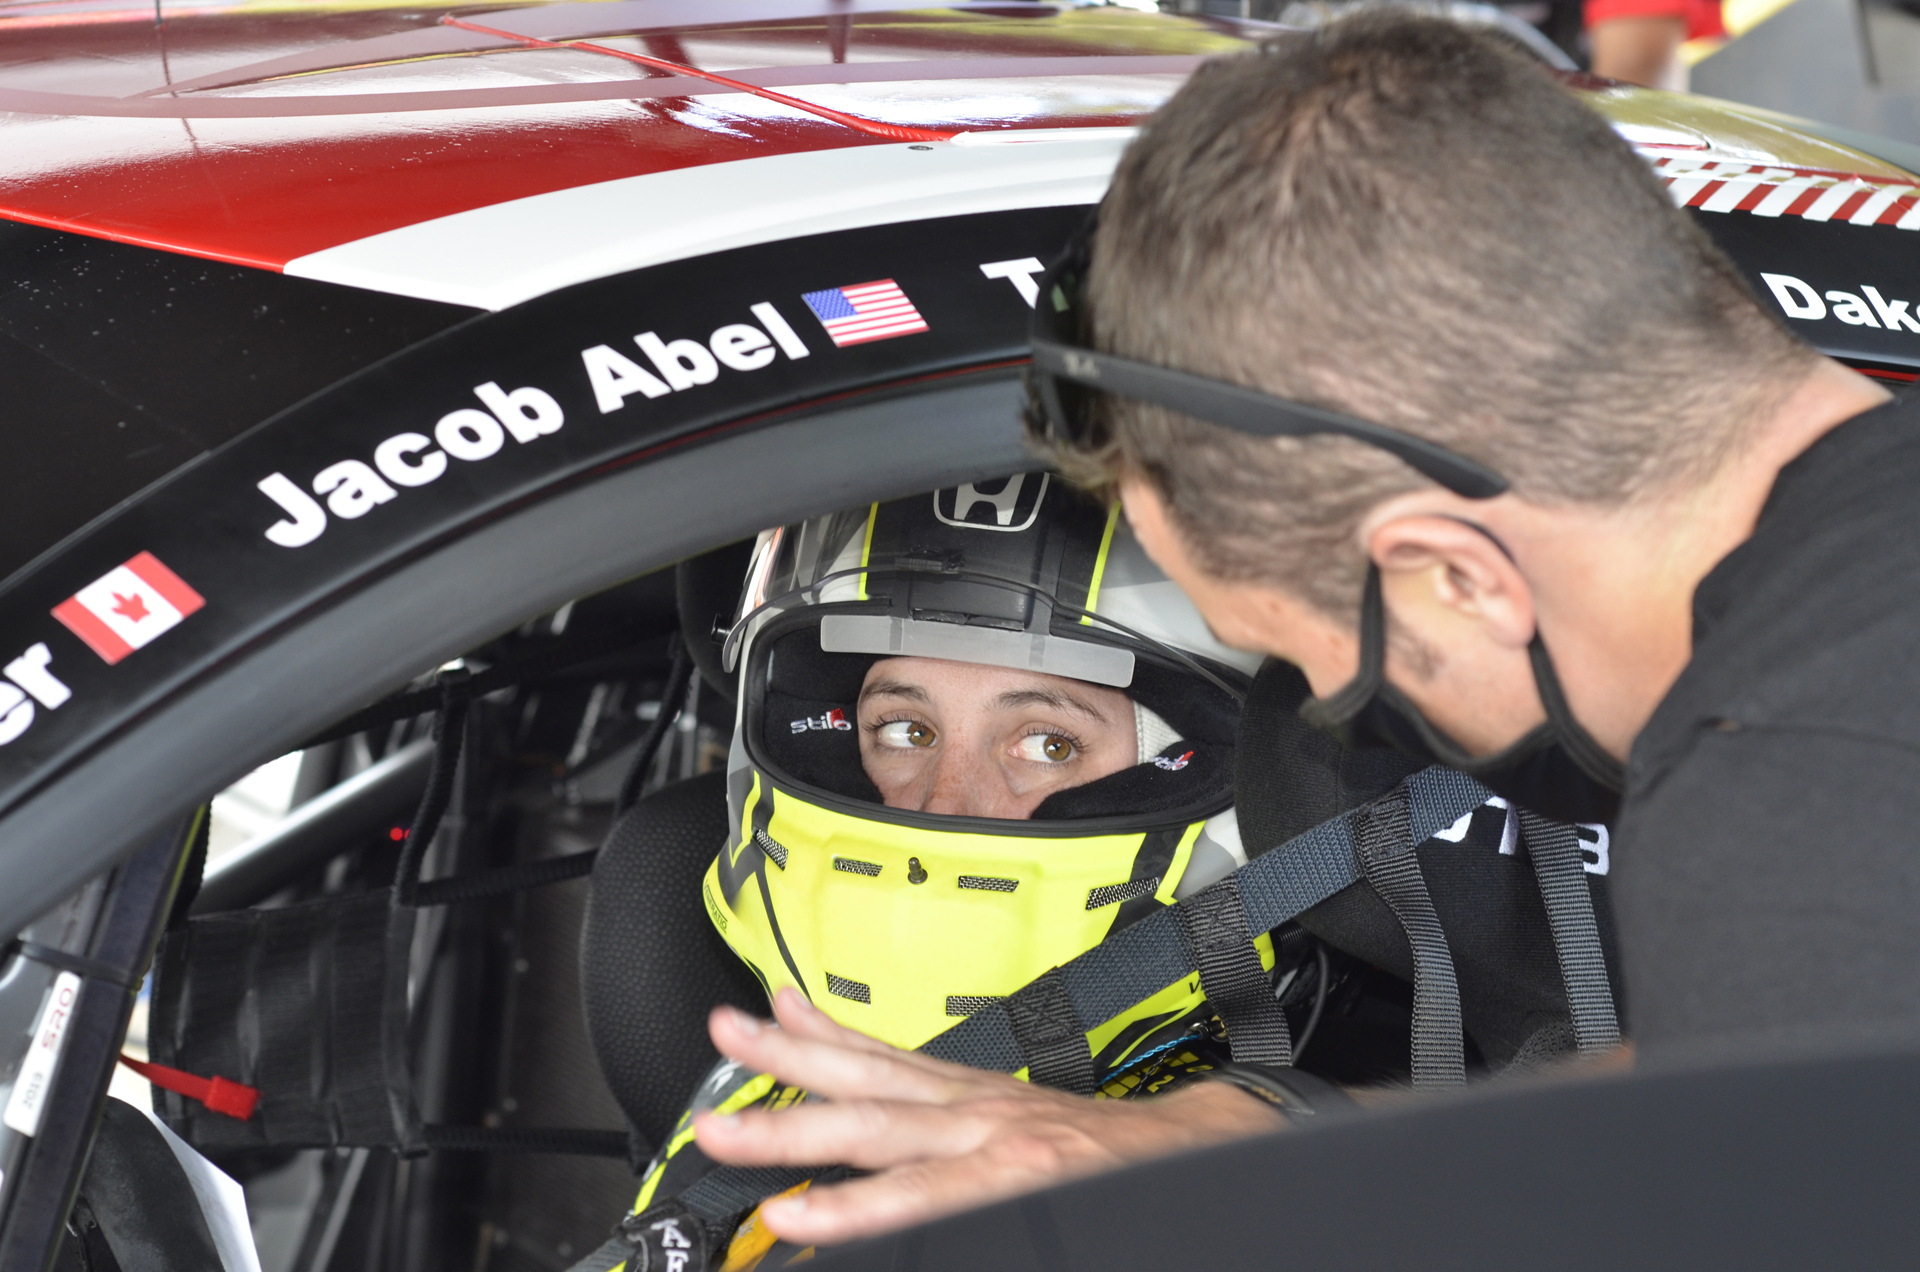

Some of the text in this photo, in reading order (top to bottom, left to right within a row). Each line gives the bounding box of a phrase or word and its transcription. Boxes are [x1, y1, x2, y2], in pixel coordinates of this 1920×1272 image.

[1760, 272, 1920, 334] Dak
[257, 302, 810, 547] Jacob Abel
[790, 708, 852, 734] stilo
[41, 987, 74, 1050] SRO
